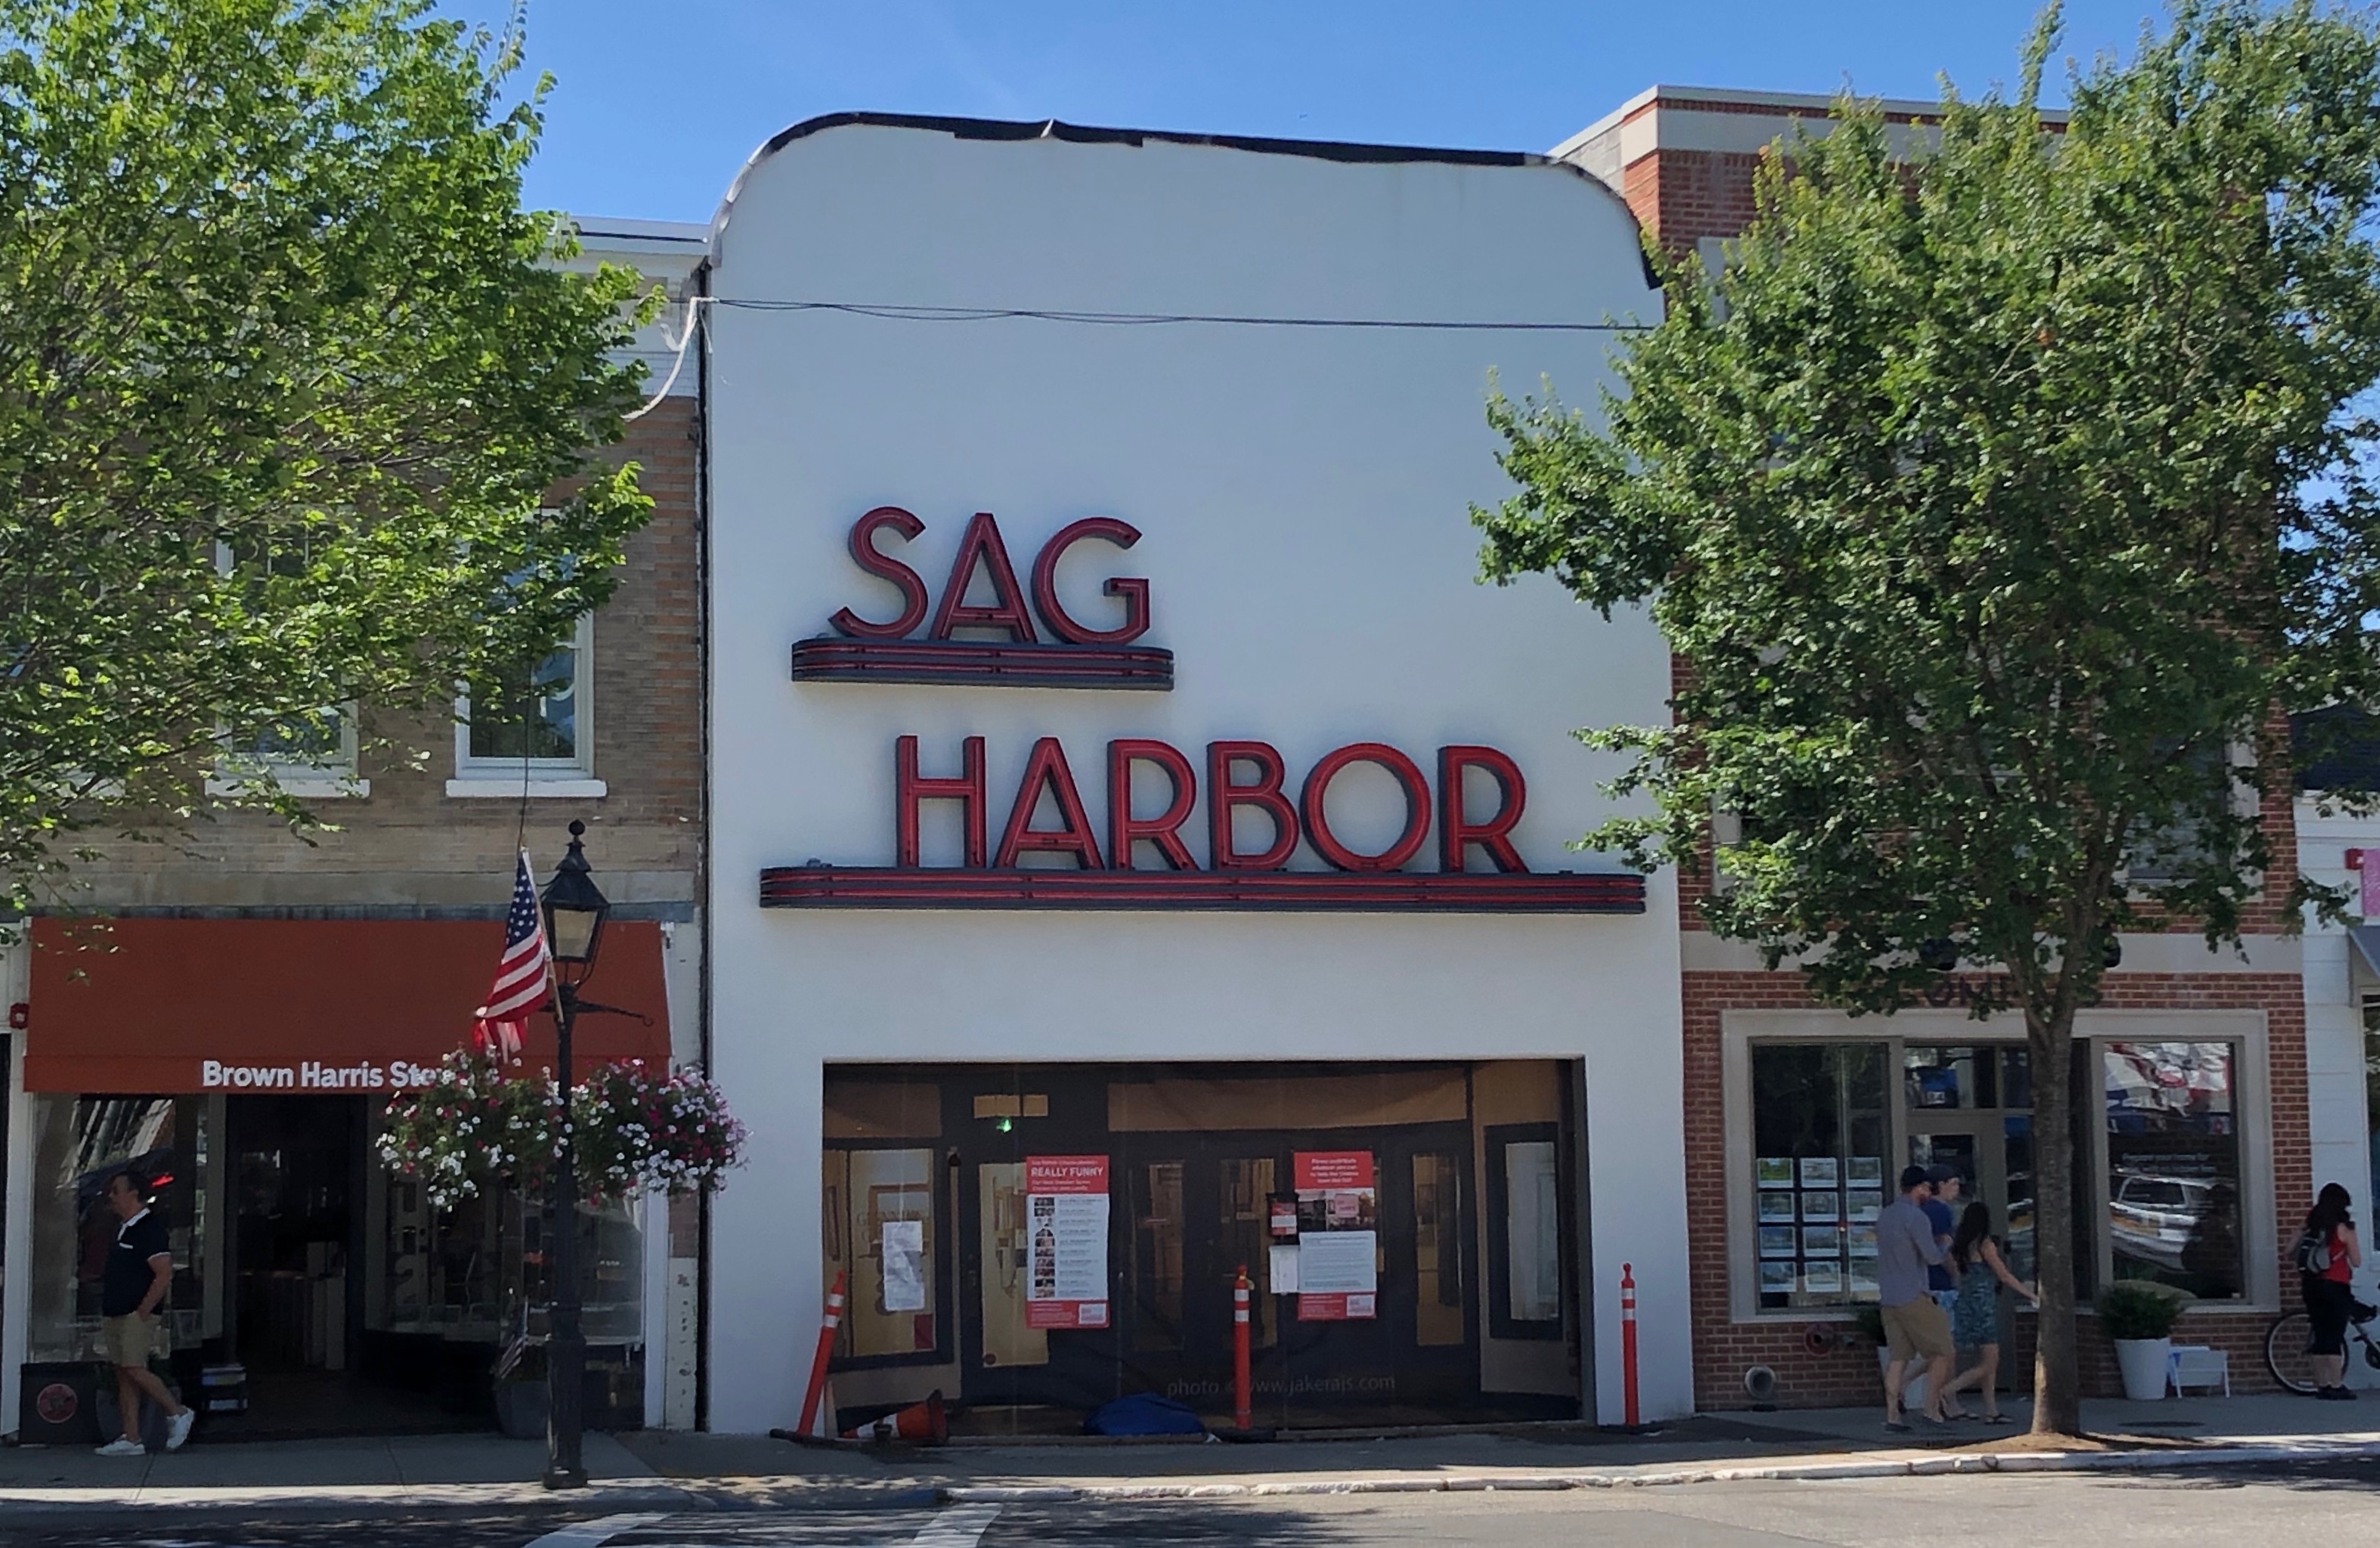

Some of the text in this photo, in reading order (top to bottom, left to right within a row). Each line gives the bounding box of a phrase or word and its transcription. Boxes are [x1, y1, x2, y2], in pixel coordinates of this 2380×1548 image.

[829, 506, 1150, 645] SAG
[896, 735, 1530, 874] HARBOR
[203, 1060, 444, 1087] Brown Harris Ste
[1030, 1166, 1103, 1177] REALLY FUNNY
[1167, 1377, 1220, 1397] photo
